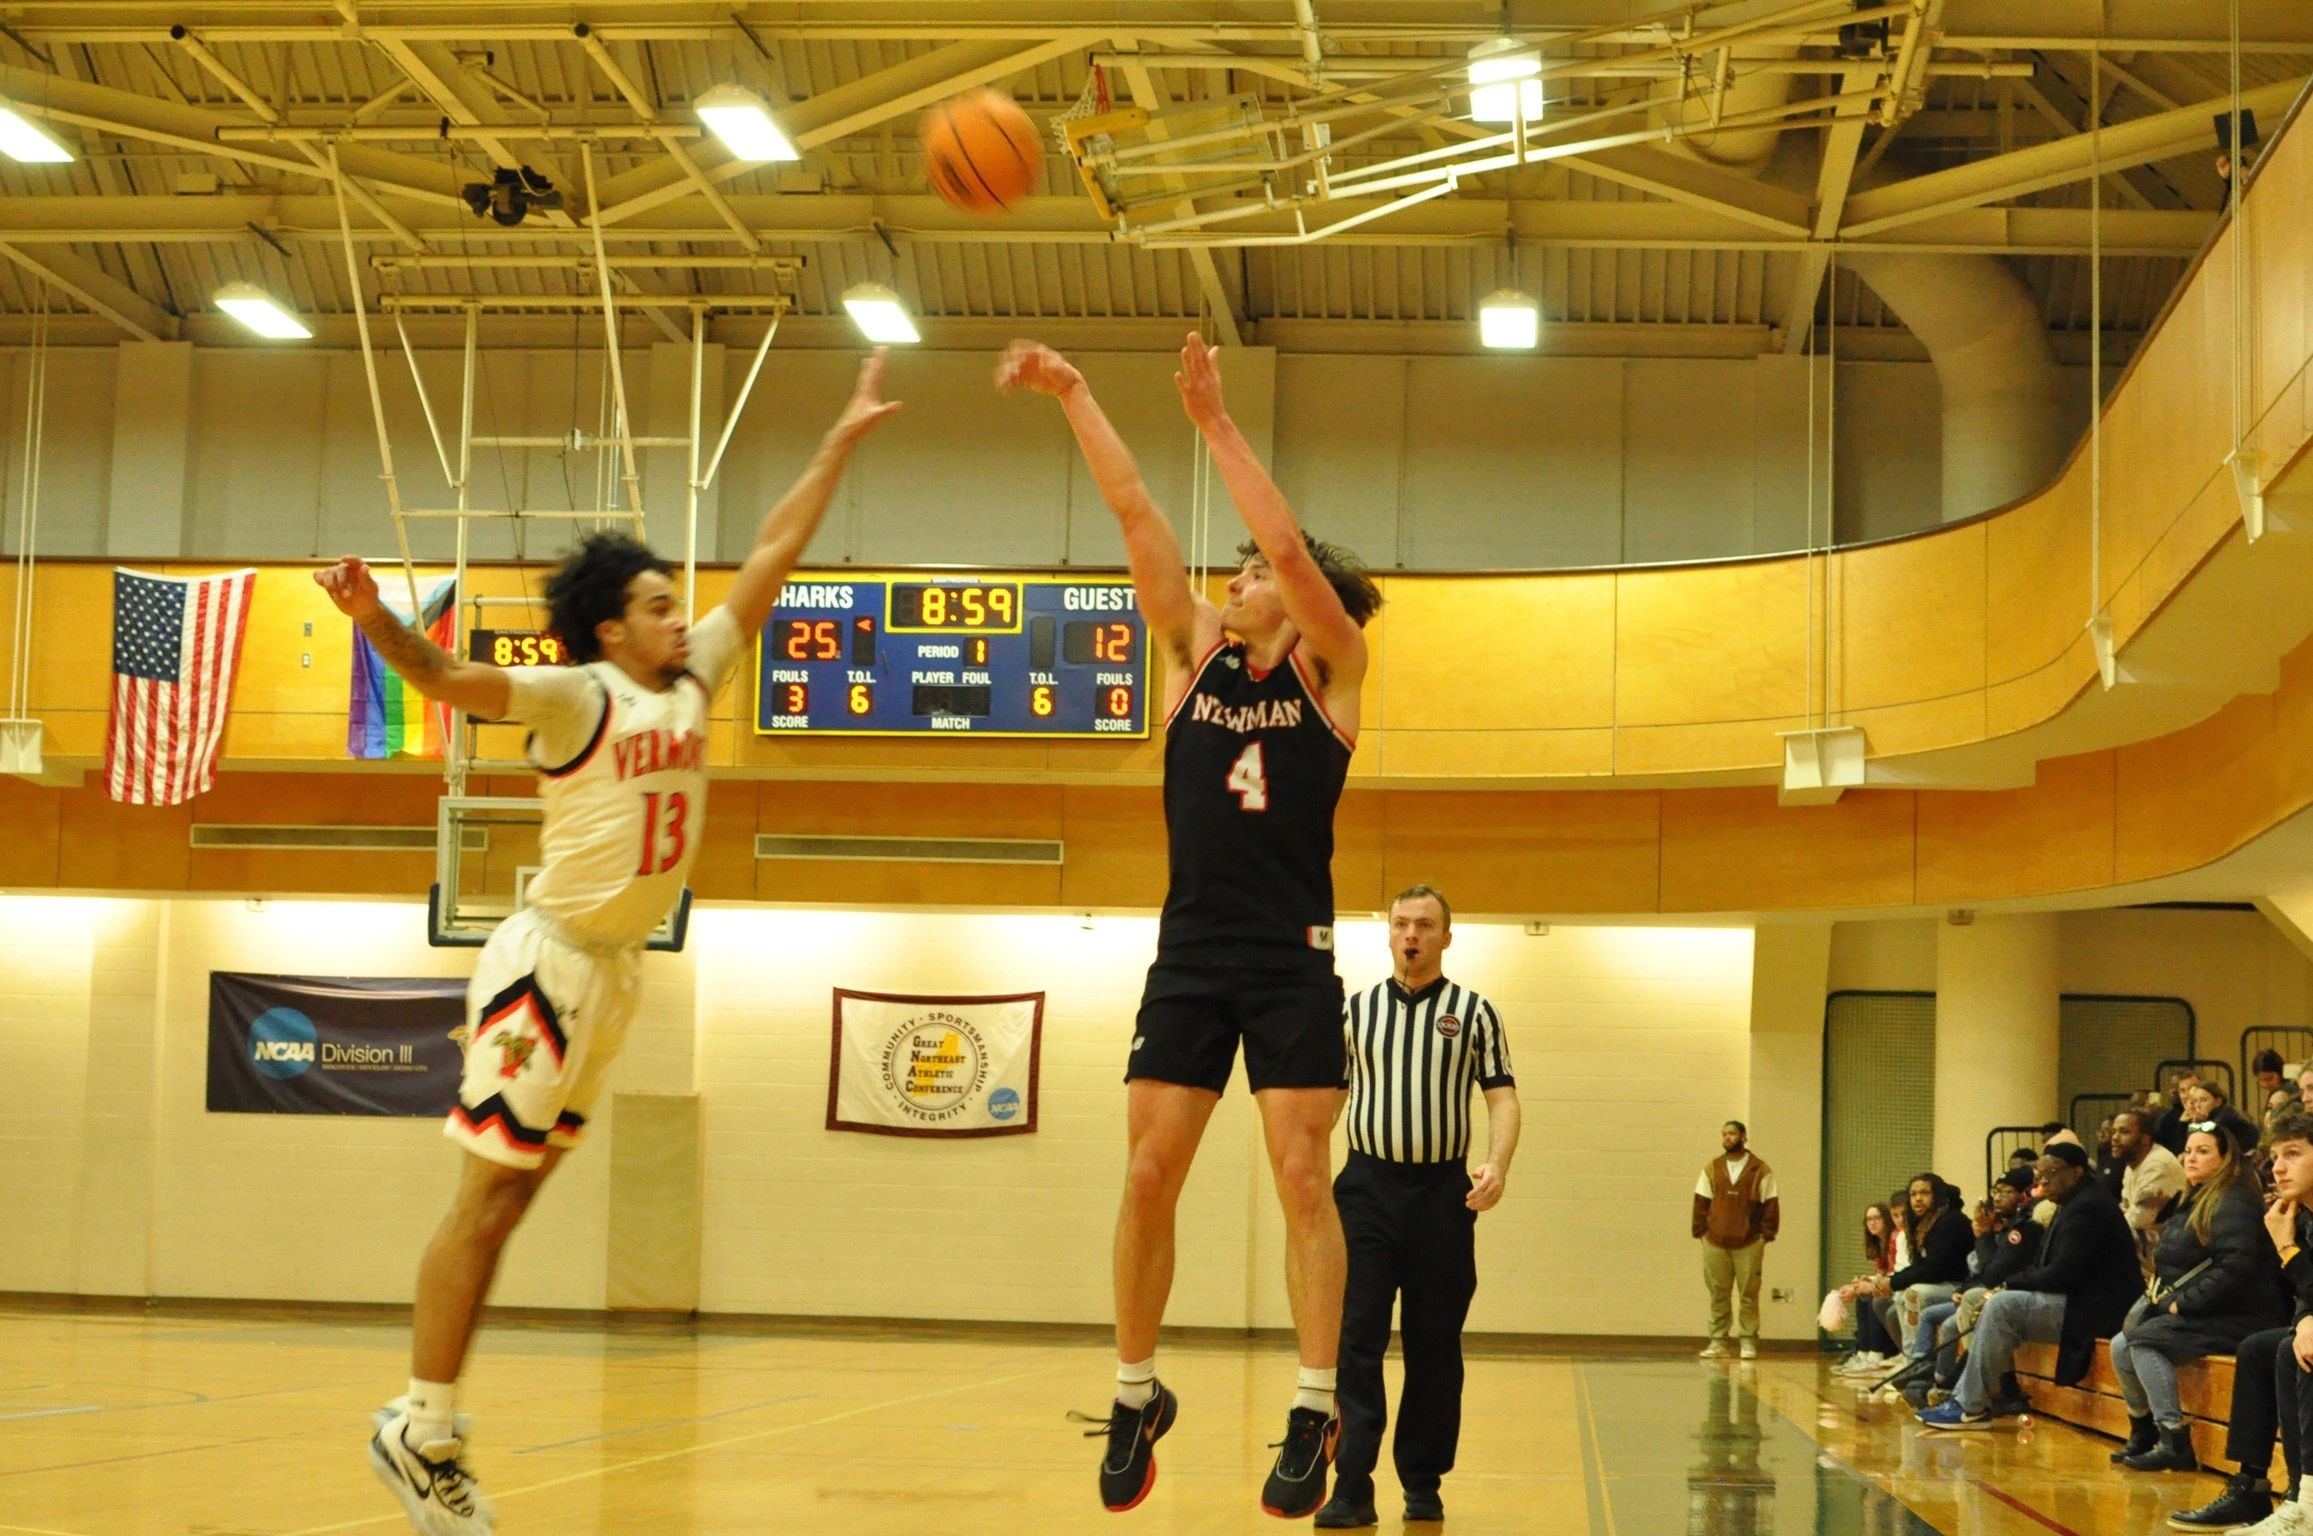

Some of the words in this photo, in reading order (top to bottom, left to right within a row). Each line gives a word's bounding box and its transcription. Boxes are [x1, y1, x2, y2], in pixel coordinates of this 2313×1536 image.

[772, 585, 853, 608] HARKS
[922, 587, 1011, 625] 8:59
[1063, 587, 1136, 611] GUEST
[495, 636, 557, 665] 8:59
[788, 621, 836, 659] 25
[917, 645, 959, 658] PERIOD
[976, 640, 985, 663] 1
[1095, 624, 1130, 661] 12
[772, 670, 808, 682] FOULS
[846, 670, 876, 683] T.O.L.
[911, 671, 954, 683] PLAYER
[962, 672, 992, 684] FOUL
[1029, 672, 1058, 685] T.O.L.
[1096, 673, 1133, 685] FOULS
[788, 685, 804, 712] 3
[850, 685, 869, 713] 6
[1033, 687, 1052, 715] 6
[1110, 688, 1128, 716] 0
[771, 715, 808, 728] SCORE
[931, 717, 970, 729] MATCH
[1094, 718, 1132, 731] SCORE
[1226, 741, 1268, 811] 4
[636, 791, 687, 875] 13
[254, 1041, 315, 1062] NCAA
[321, 1043, 394, 1064] Division
[399, 1044, 413, 1064] III
[881, 1018, 916, 1090] COMMUNITY
[928, 1012, 989, 1092] SPORTSMANSHIP
[898, 1101, 967, 1121] INTEGRITY
